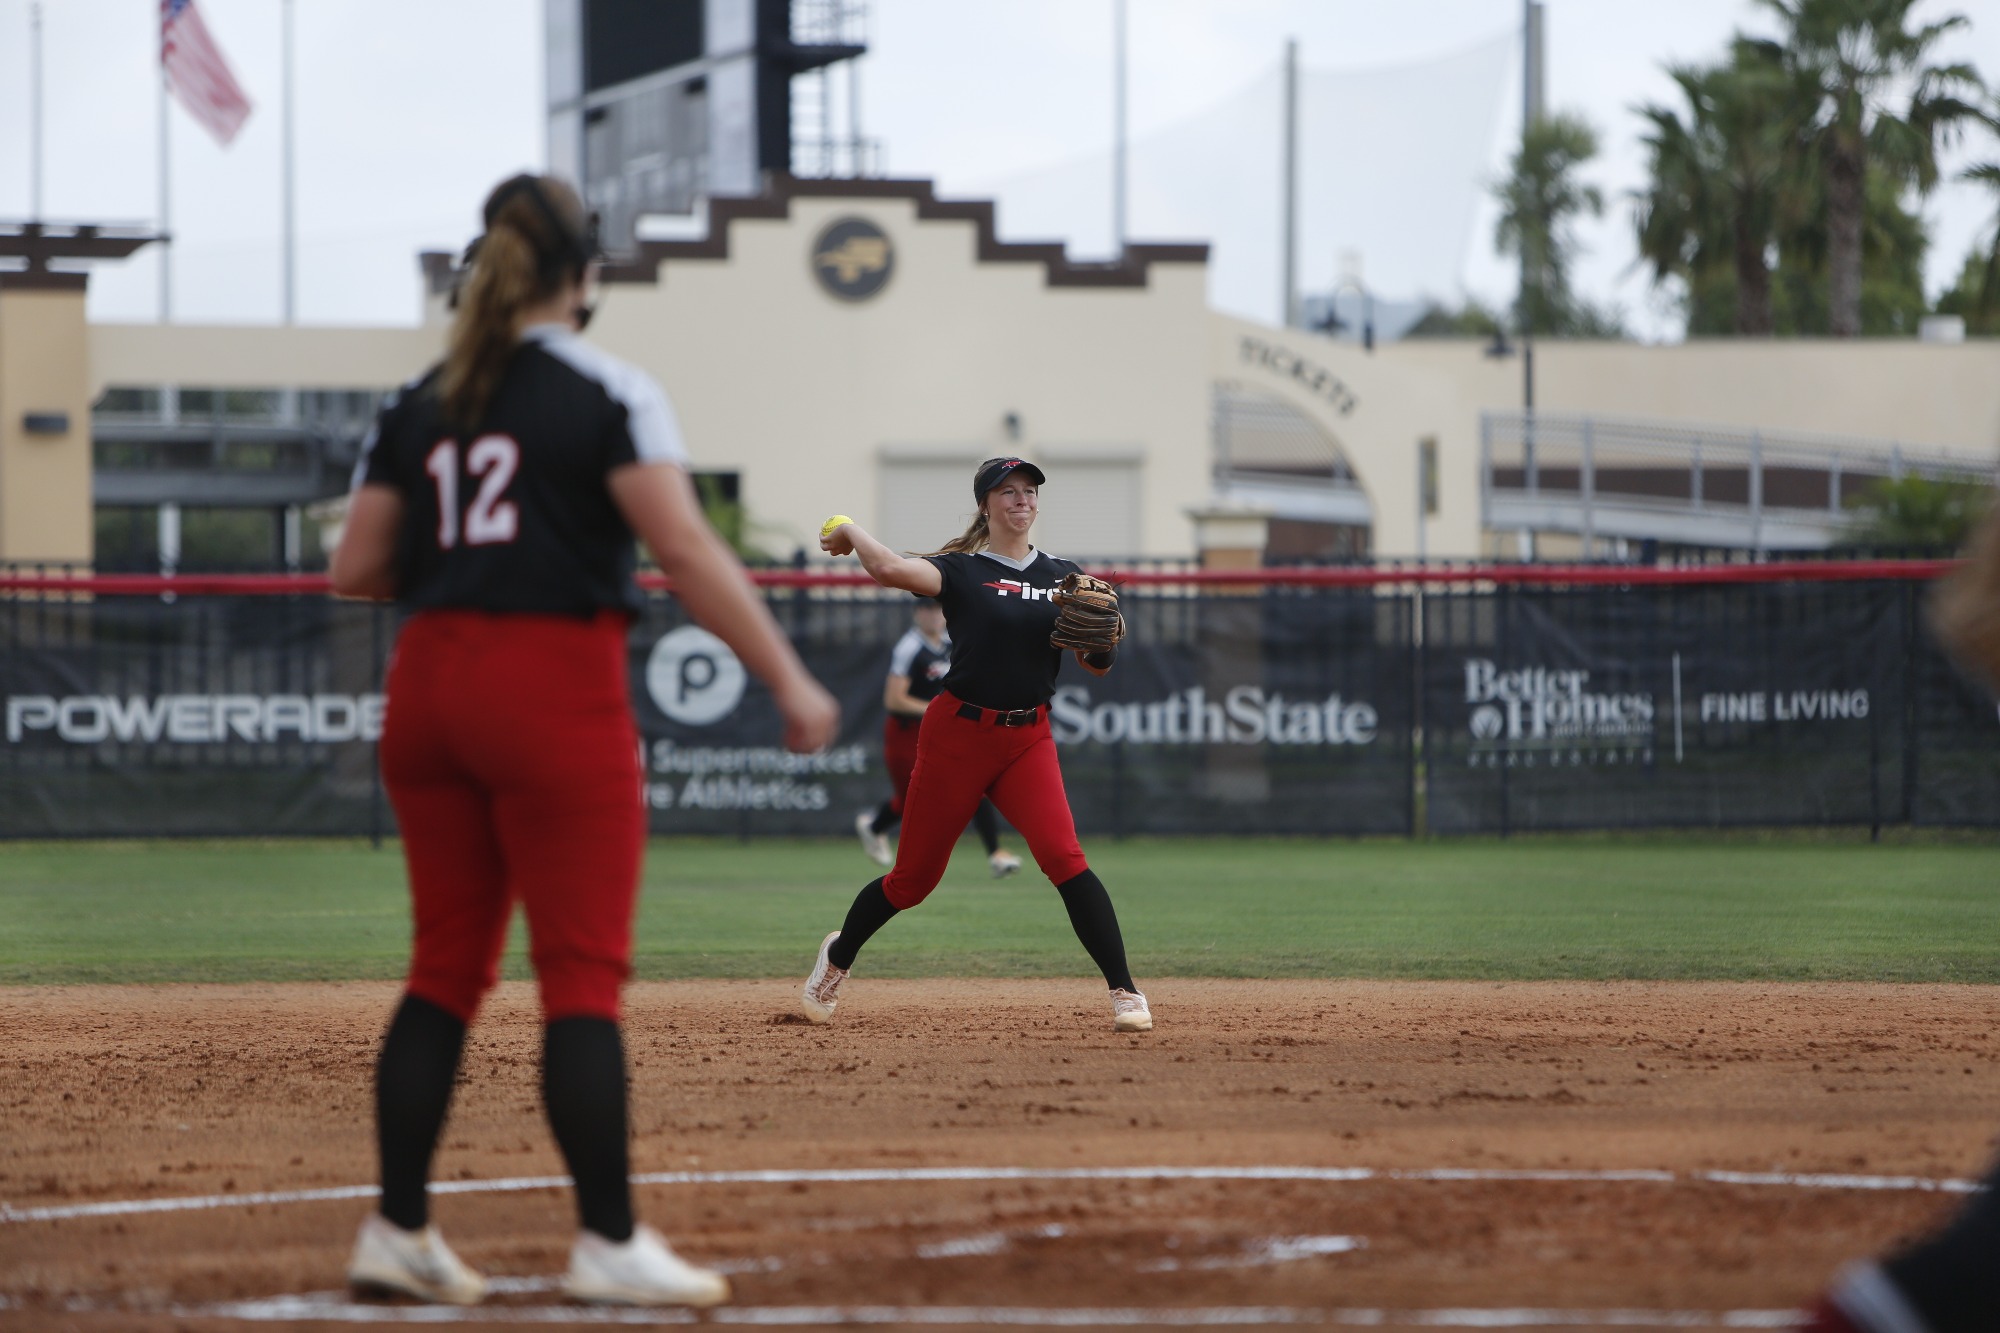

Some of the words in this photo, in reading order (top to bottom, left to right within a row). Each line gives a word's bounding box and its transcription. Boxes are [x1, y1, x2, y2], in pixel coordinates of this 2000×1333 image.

[1240, 335, 1358, 417] TICKETS
[425, 433, 520, 550] 12
[1465, 659, 1589, 702] Better
[6, 695, 386, 742] POWERADE
[1051, 685, 1378, 744] SouthState
[1506, 693, 1654, 739] Homes
[1701, 692, 1767, 722] FINE
[1774, 689, 1869, 720] LIVING
[653, 738, 866, 774] Supermarket
[679, 775, 829, 810] Athletics
